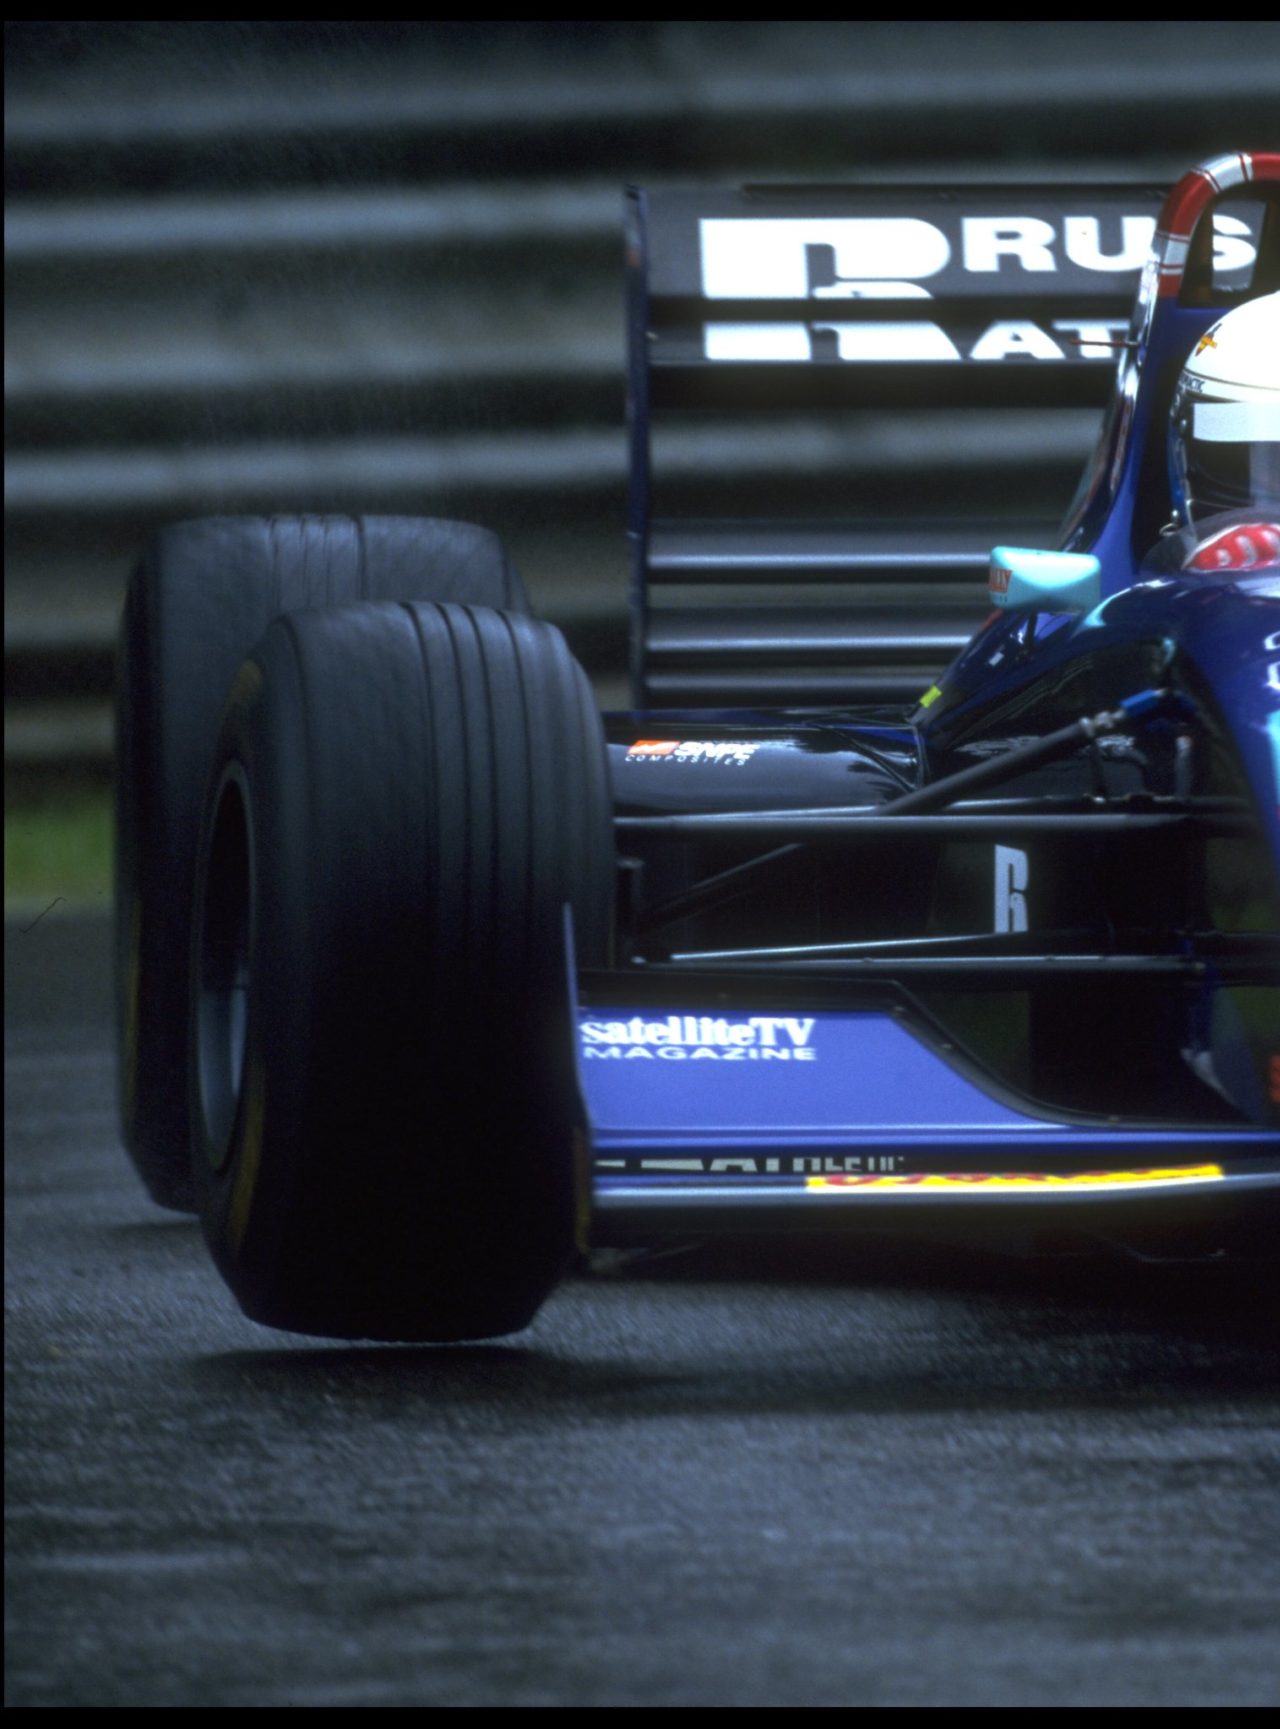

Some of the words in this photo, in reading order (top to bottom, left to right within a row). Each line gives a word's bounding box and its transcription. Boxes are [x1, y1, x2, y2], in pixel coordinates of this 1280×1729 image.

[624, 754, 746, 767] COMPOSITES
[994, 844, 1029, 934] R
[582, 1046, 817, 1061] MAGAZINE
